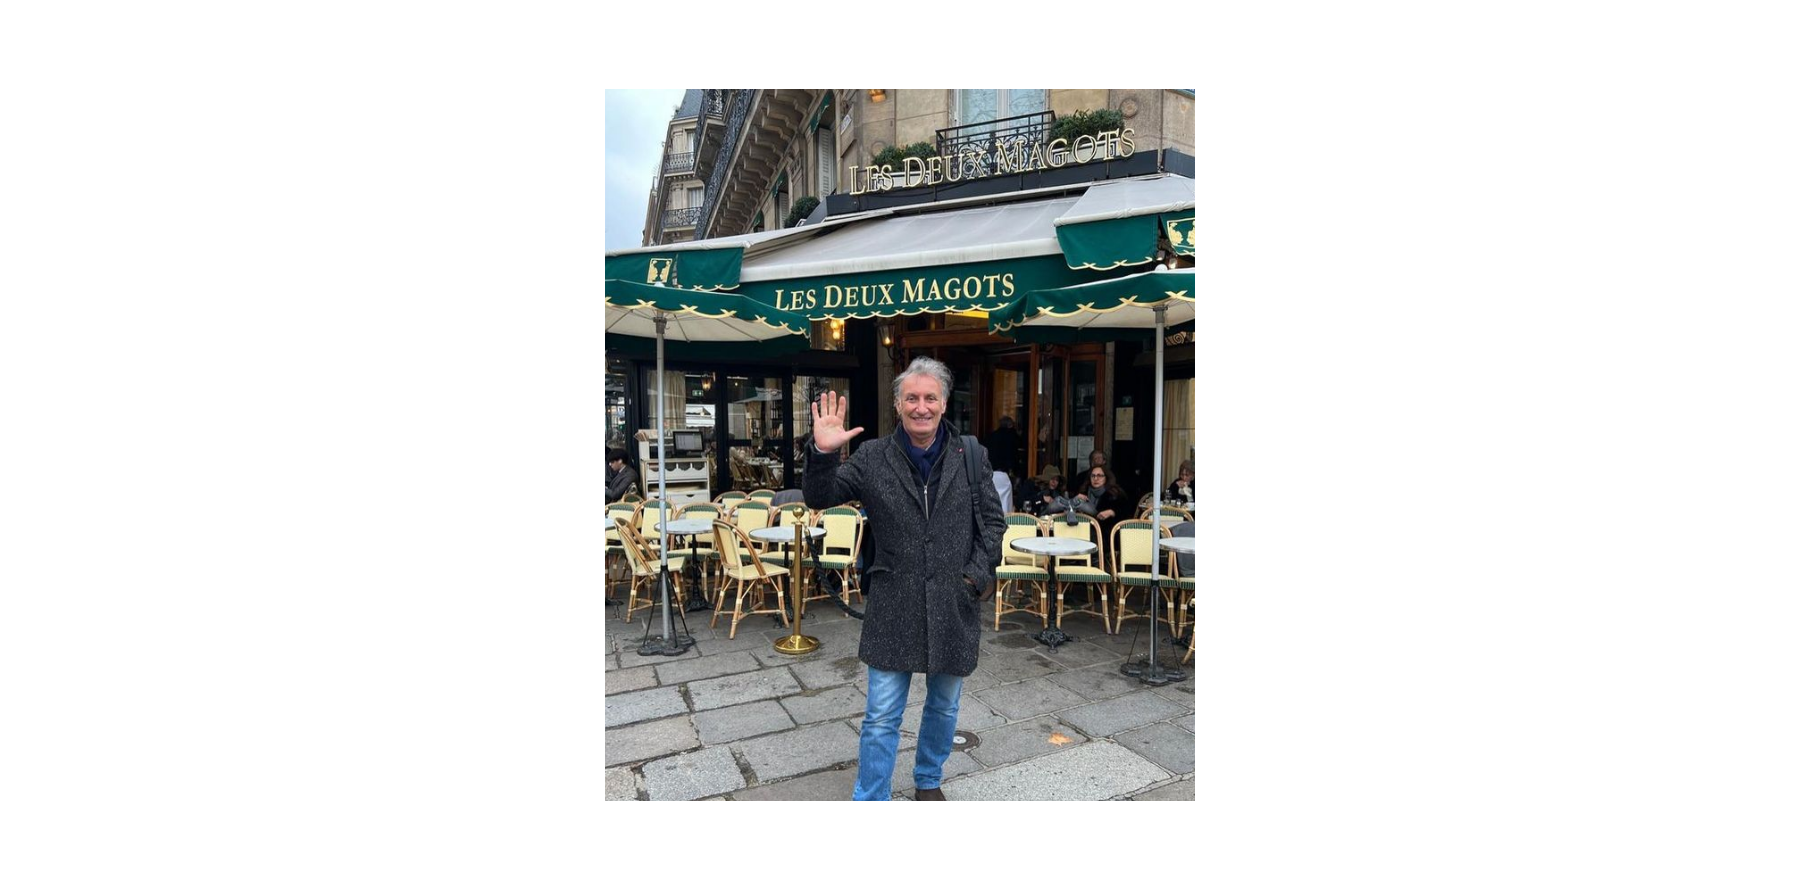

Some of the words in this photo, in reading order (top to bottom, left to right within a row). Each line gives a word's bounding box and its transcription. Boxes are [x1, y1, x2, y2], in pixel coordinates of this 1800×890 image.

[849, 164, 894, 195] LES
[902, 151, 987, 188] DEUX
[994, 128, 1136, 175] MAGOTS
[775, 288, 817, 311] LES
[823, 283, 895, 309] DEUX
[901, 273, 1015, 304] MAGOTS
